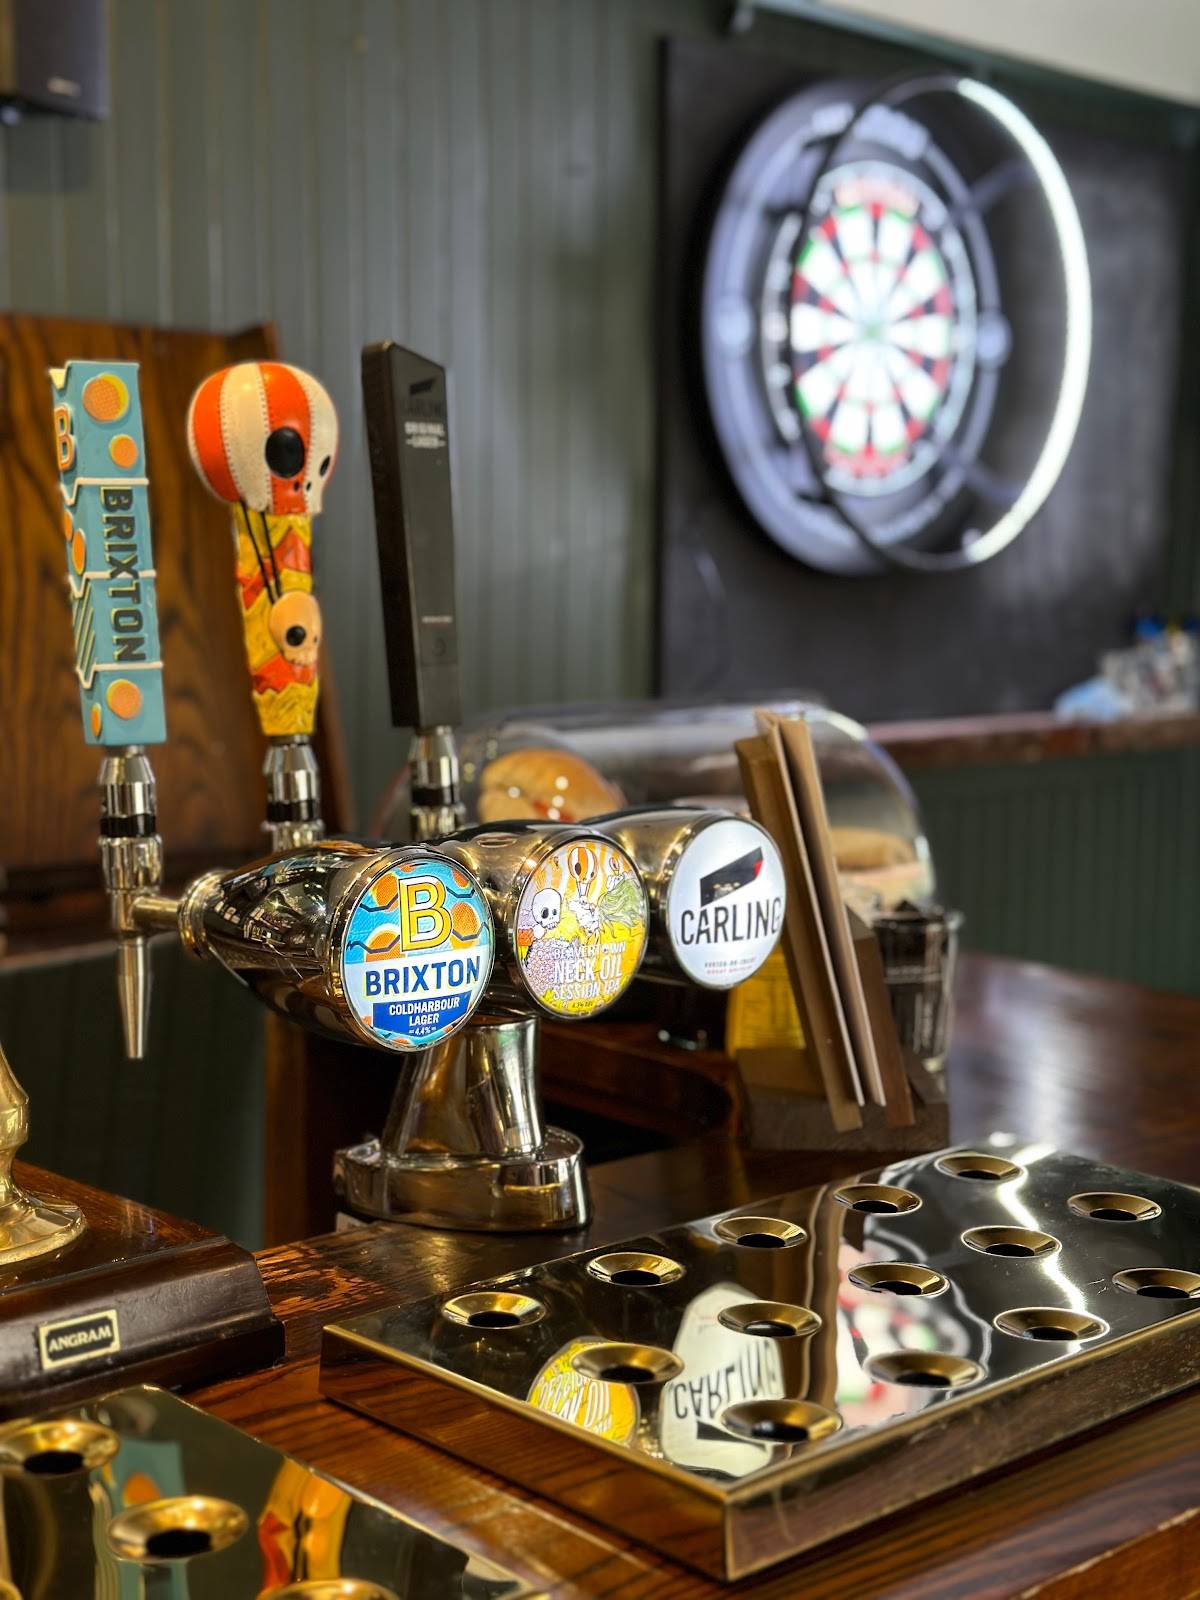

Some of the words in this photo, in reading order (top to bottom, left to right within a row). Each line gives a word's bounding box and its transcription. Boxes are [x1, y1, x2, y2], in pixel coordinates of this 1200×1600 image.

[54, 404, 76, 471] B
[100, 486, 147, 662] BRIXTON
[398, 875, 453, 952] B
[680, 897, 781, 945] CARLING
[365, 956, 480, 996] BRIXTON
[554, 958, 595, 984] NECK
[600, 955, 622, 980] OIL
[389, 997, 460, 1016] COLDHARBOUR
[553, 981, 600, 1000] SESSION
[409, 1015, 439, 1027] LAGER
[48, 1325, 112, 1353] ANGRAM
